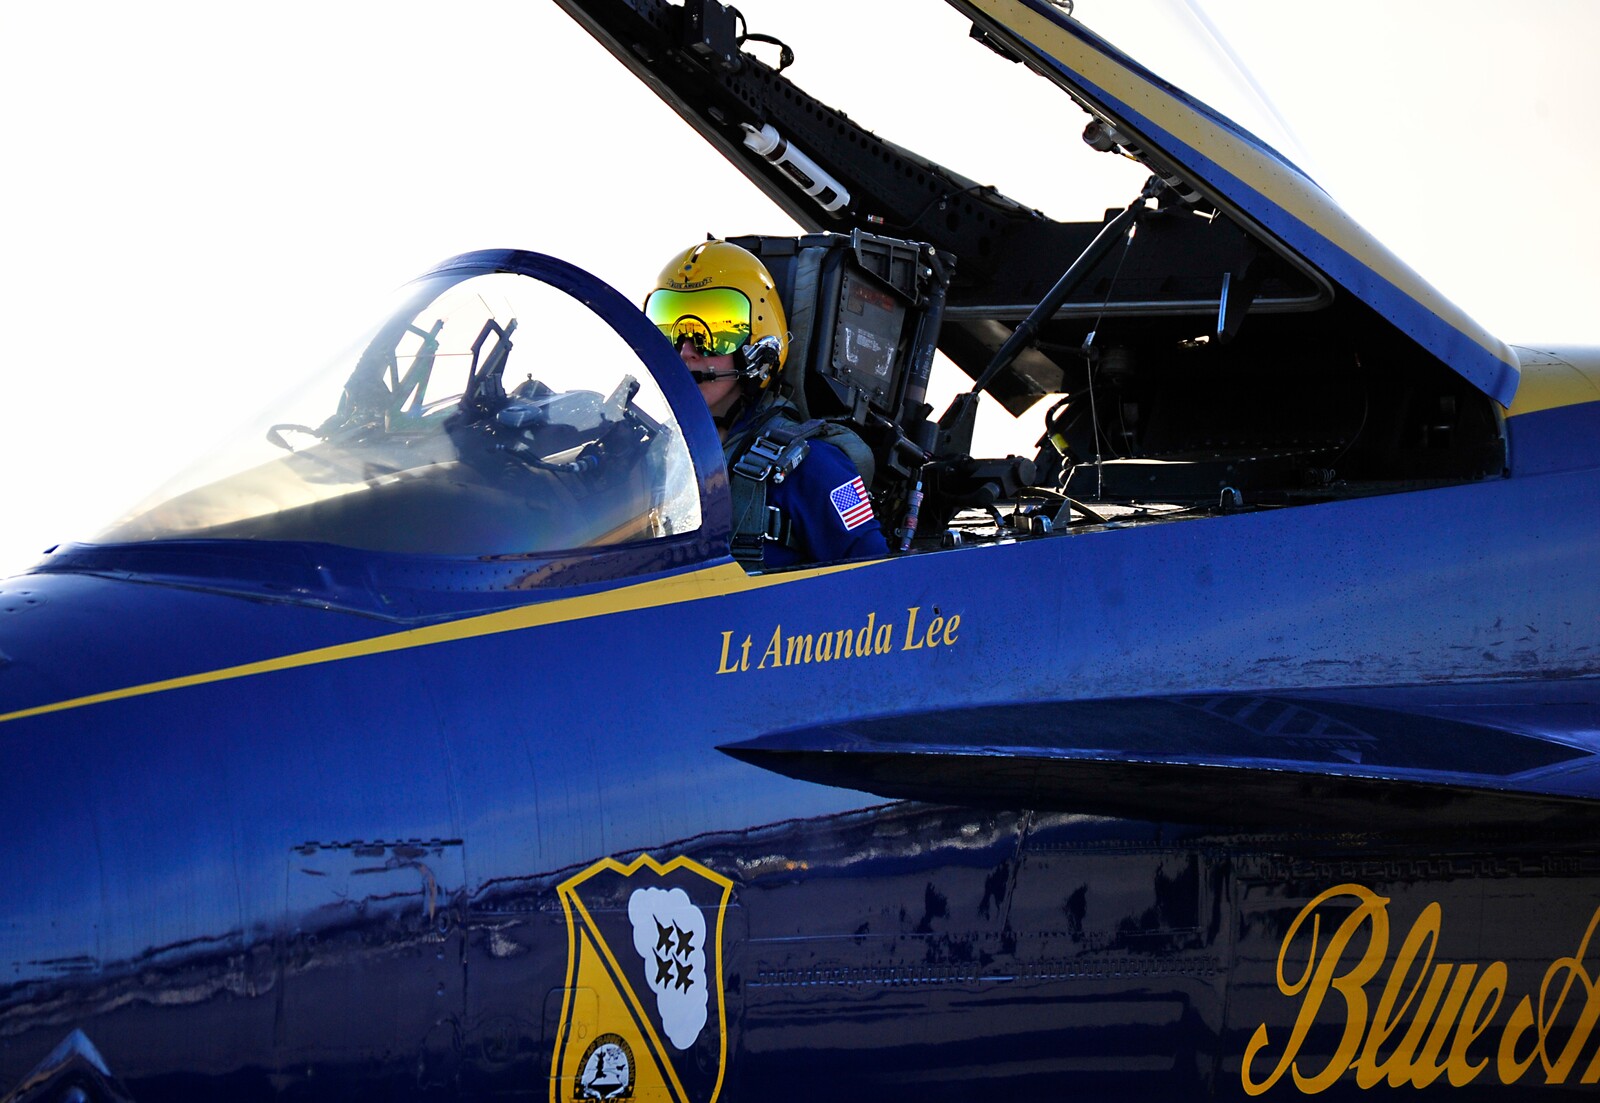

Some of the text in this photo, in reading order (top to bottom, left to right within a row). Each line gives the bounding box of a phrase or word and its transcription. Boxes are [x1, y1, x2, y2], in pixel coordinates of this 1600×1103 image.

[715, 606, 962, 675] Lt Amanda Lee
[1241, 883, 1509, 1096] Blue
